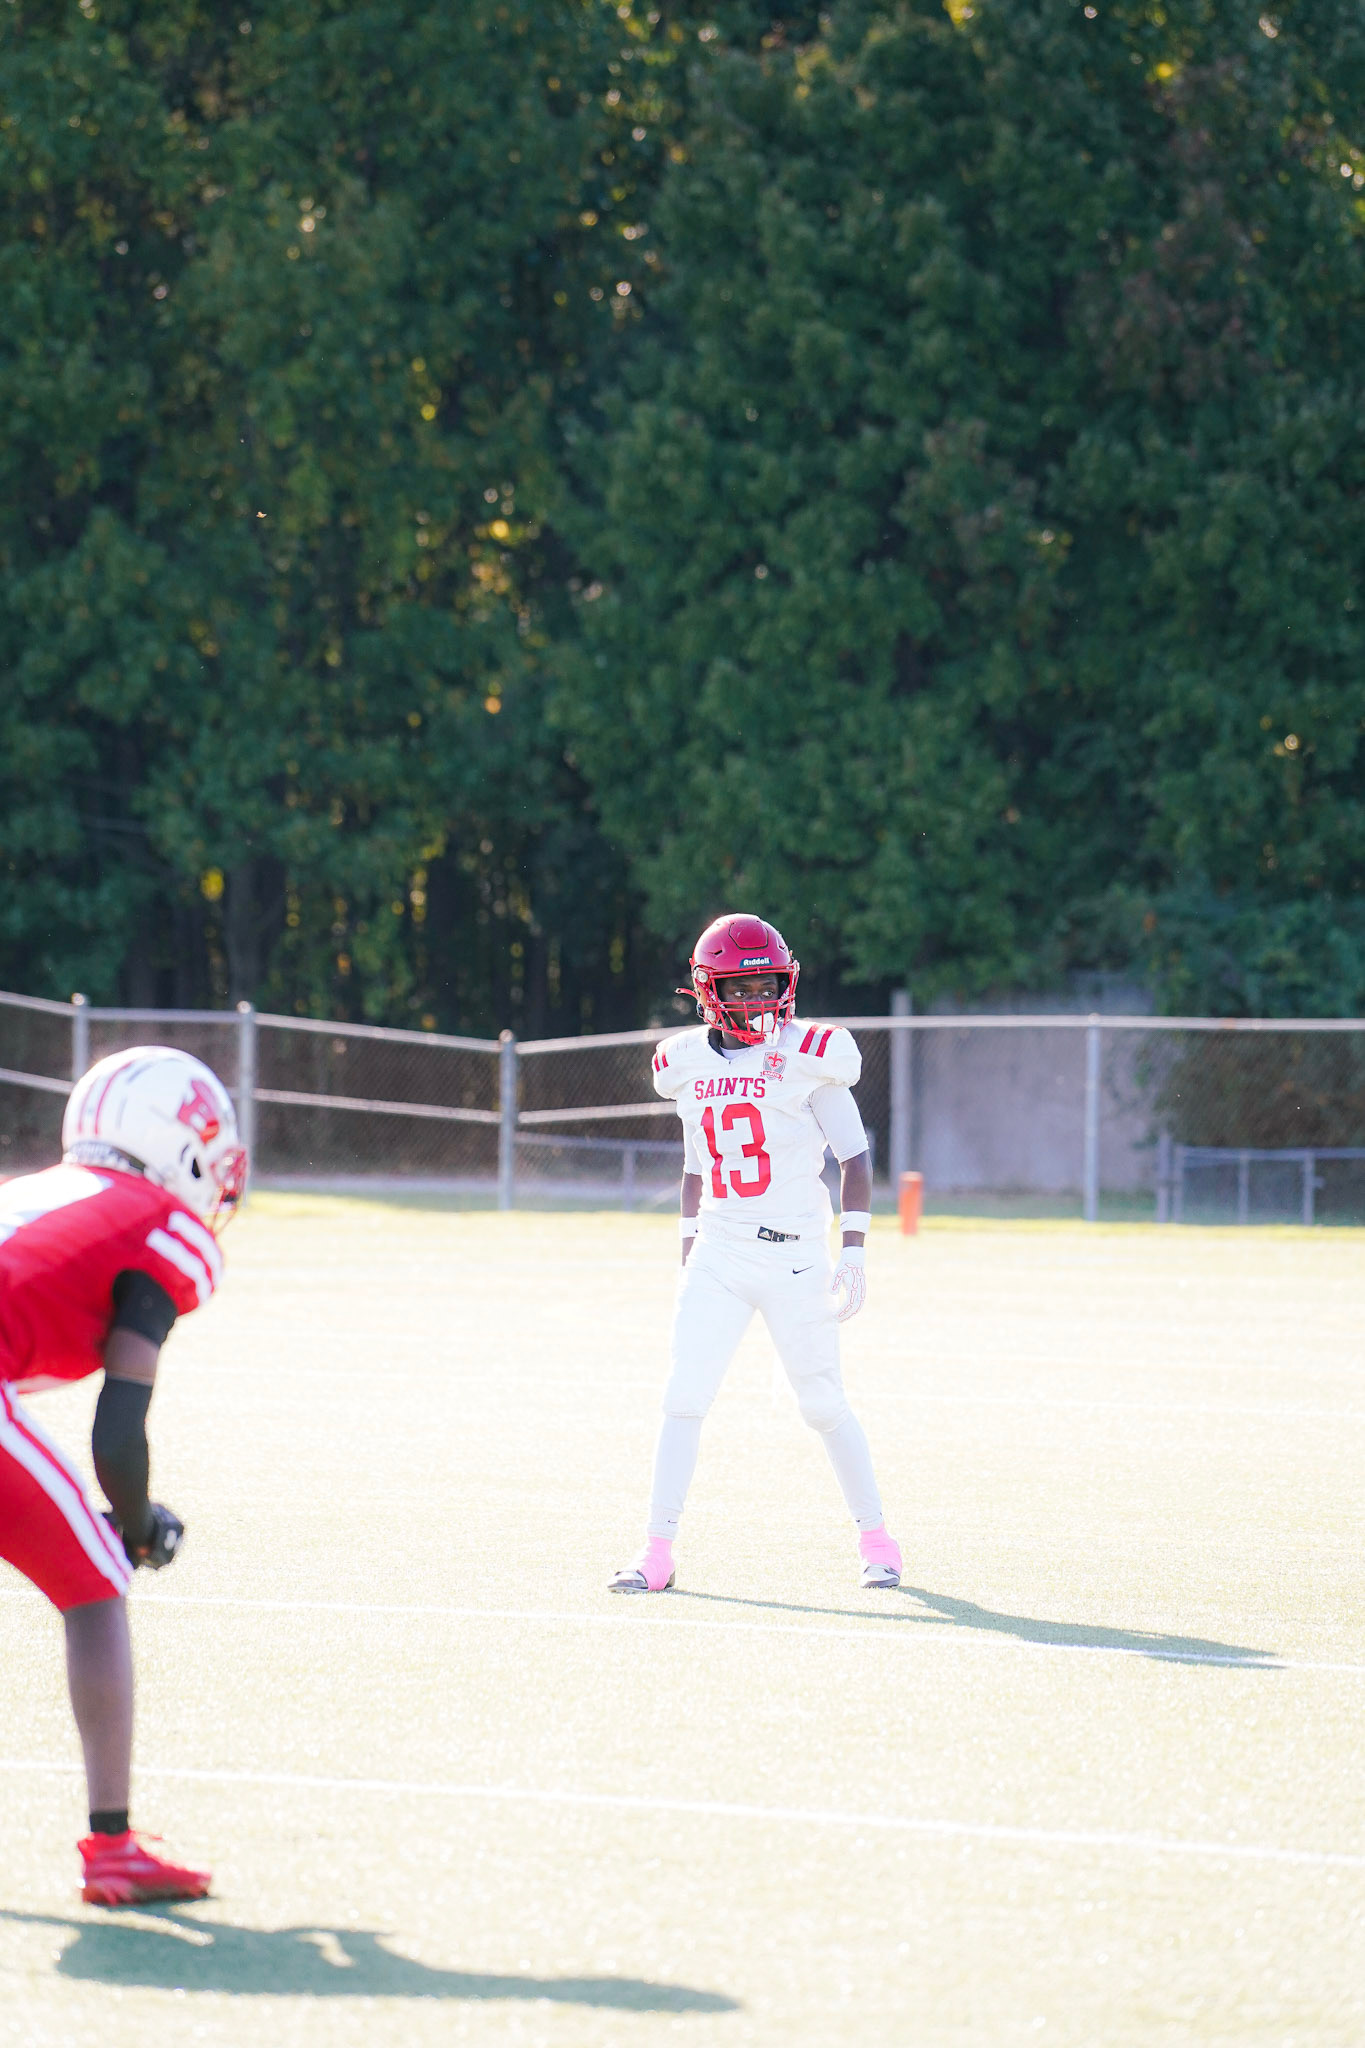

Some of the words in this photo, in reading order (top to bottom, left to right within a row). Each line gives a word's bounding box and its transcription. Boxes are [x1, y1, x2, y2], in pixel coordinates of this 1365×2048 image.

[743, 957, 769, 966] Riddell
[695, 1077, 765, 1100] SAINTS
[700, 1102, 771, 1198] 13
